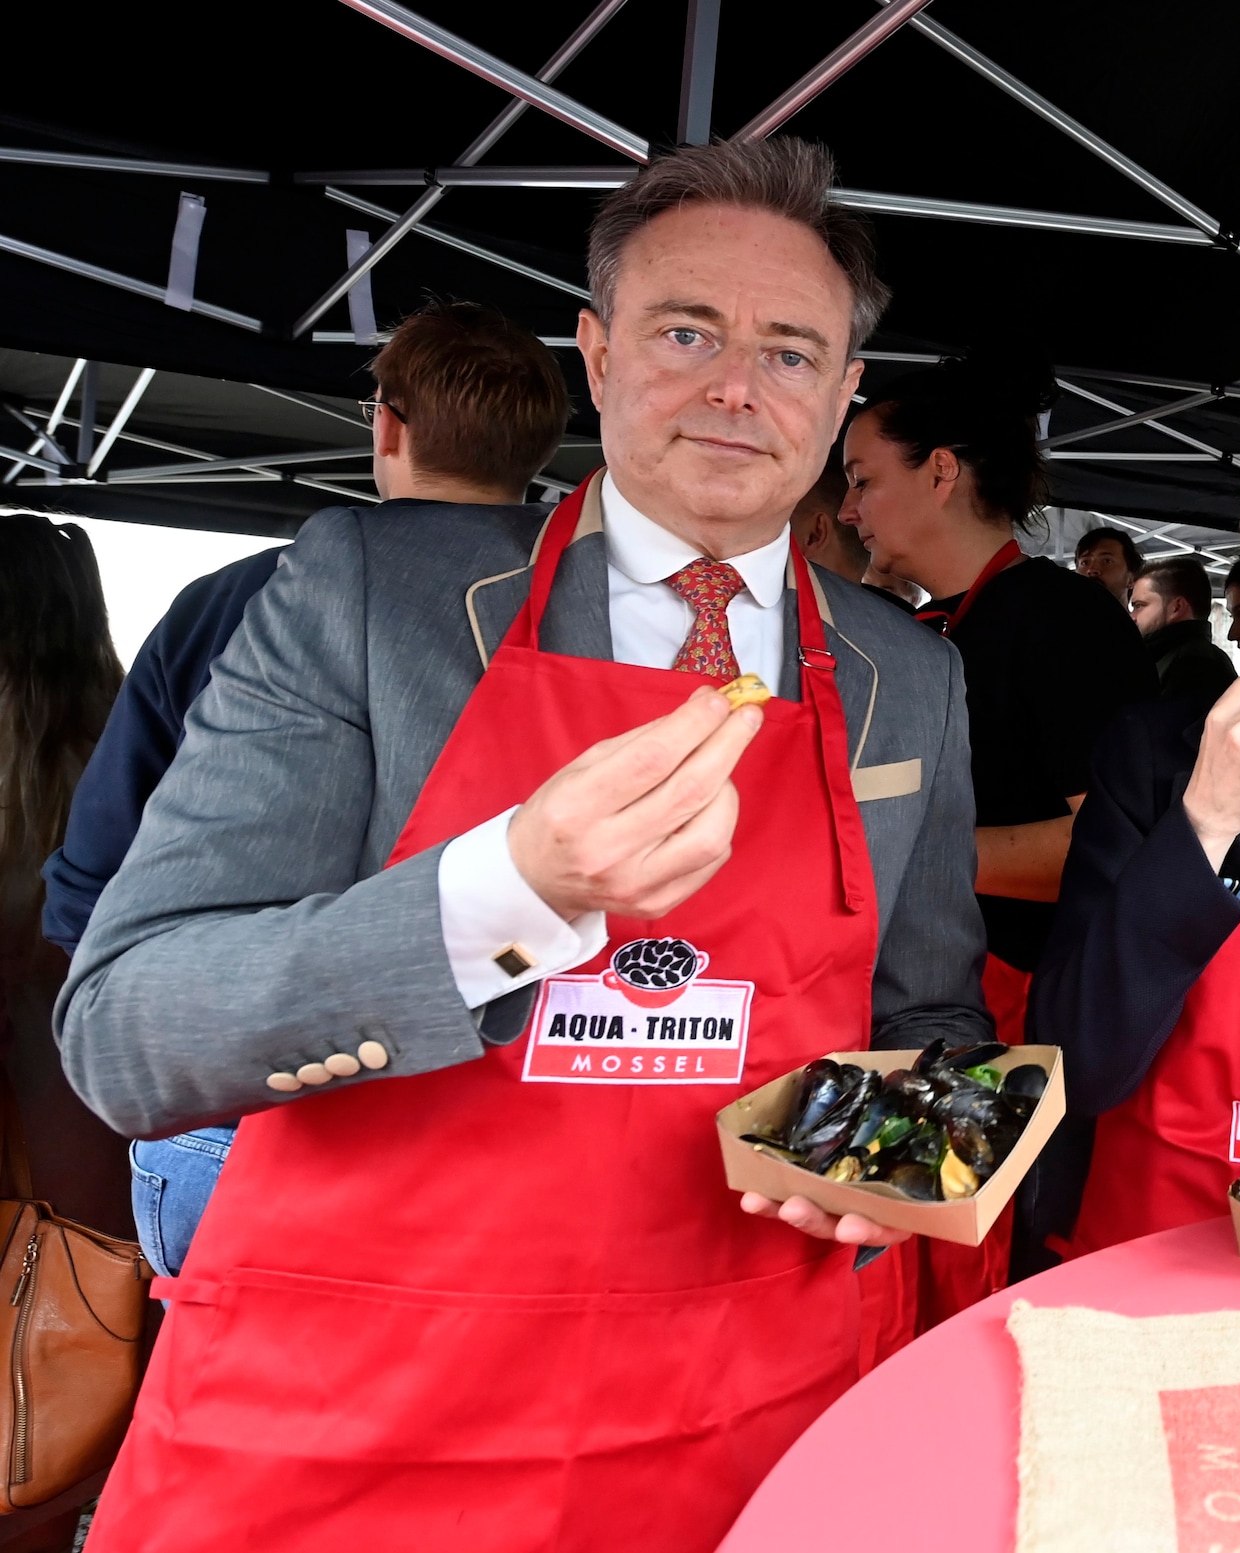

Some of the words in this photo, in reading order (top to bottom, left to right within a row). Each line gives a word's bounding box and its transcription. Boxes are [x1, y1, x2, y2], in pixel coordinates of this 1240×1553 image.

[548, 1013, 624, 1041] AQUA
[646, 1016, 735, 1041] TRITON
[571, 1053, 706, 1074] MOSSEL
